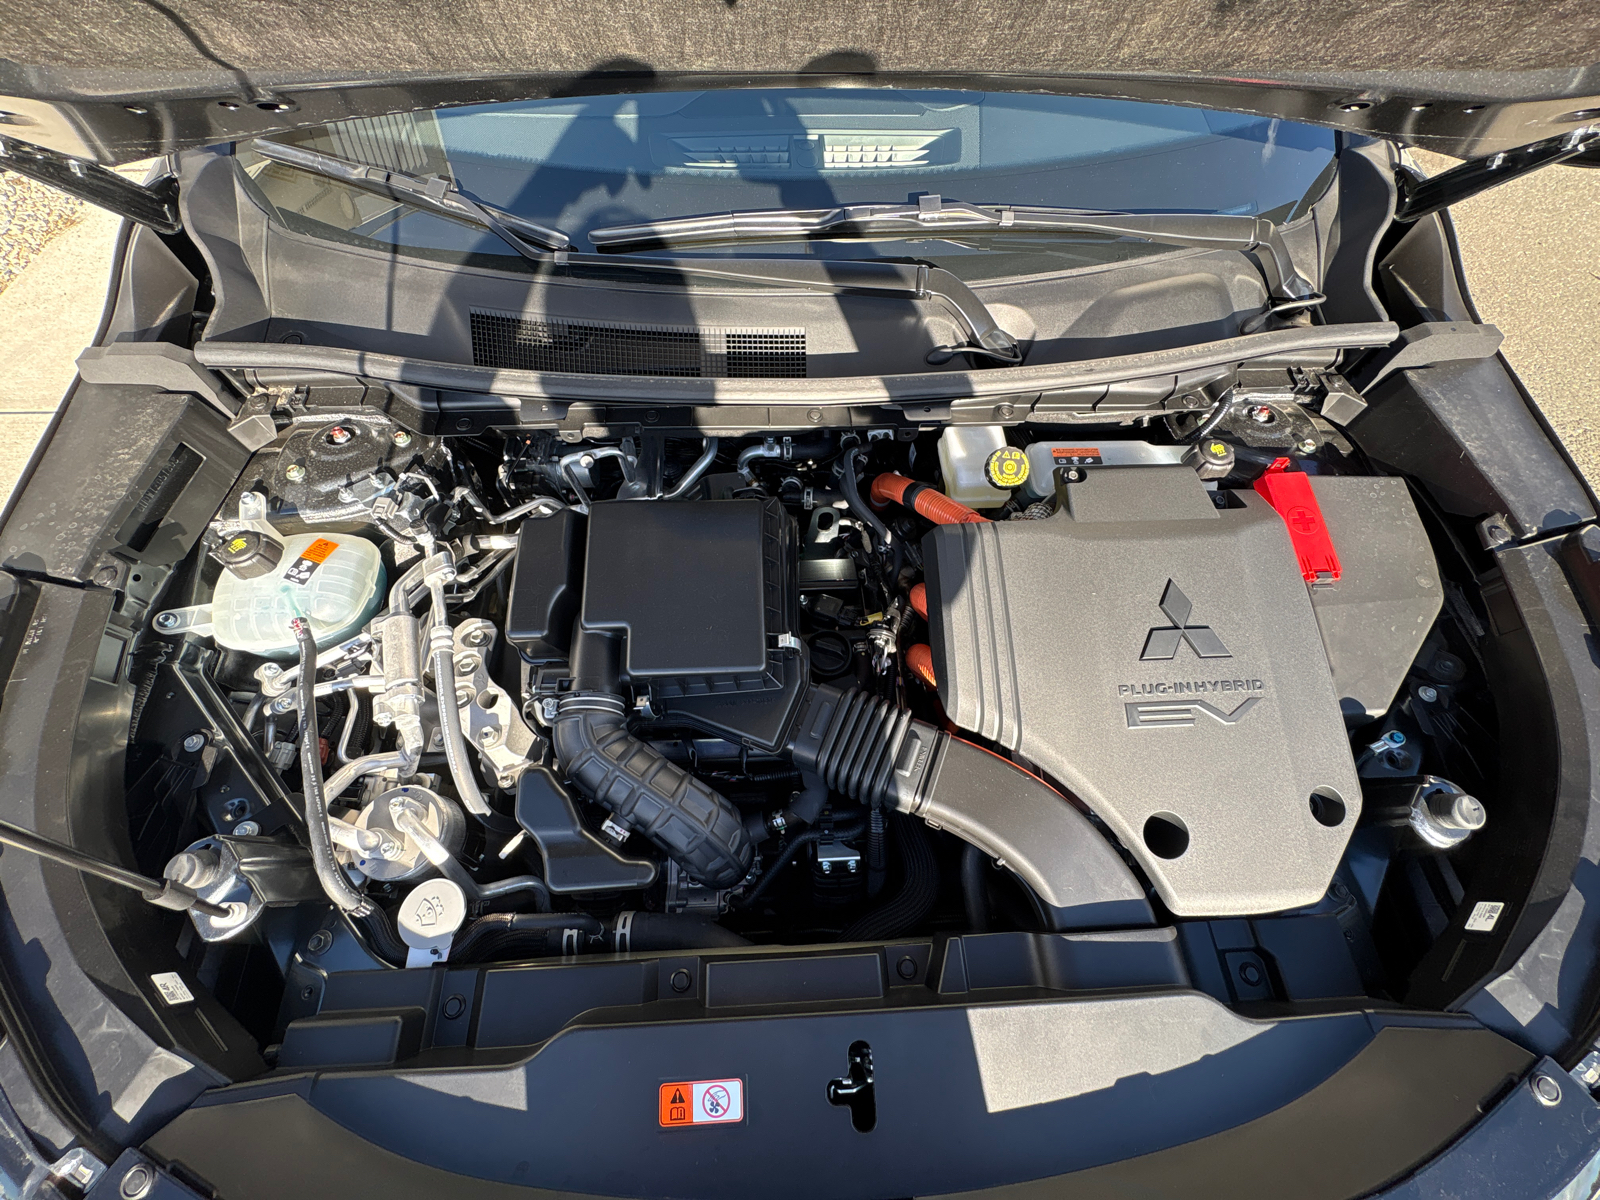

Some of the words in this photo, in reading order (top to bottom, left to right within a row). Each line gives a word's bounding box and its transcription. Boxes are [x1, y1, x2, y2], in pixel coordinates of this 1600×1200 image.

[1118, 681, 1192, 697] PLUG-IN
[1193, 679, 1265, 694] HYBRID
[1124, 697, 1264, 729] EV
